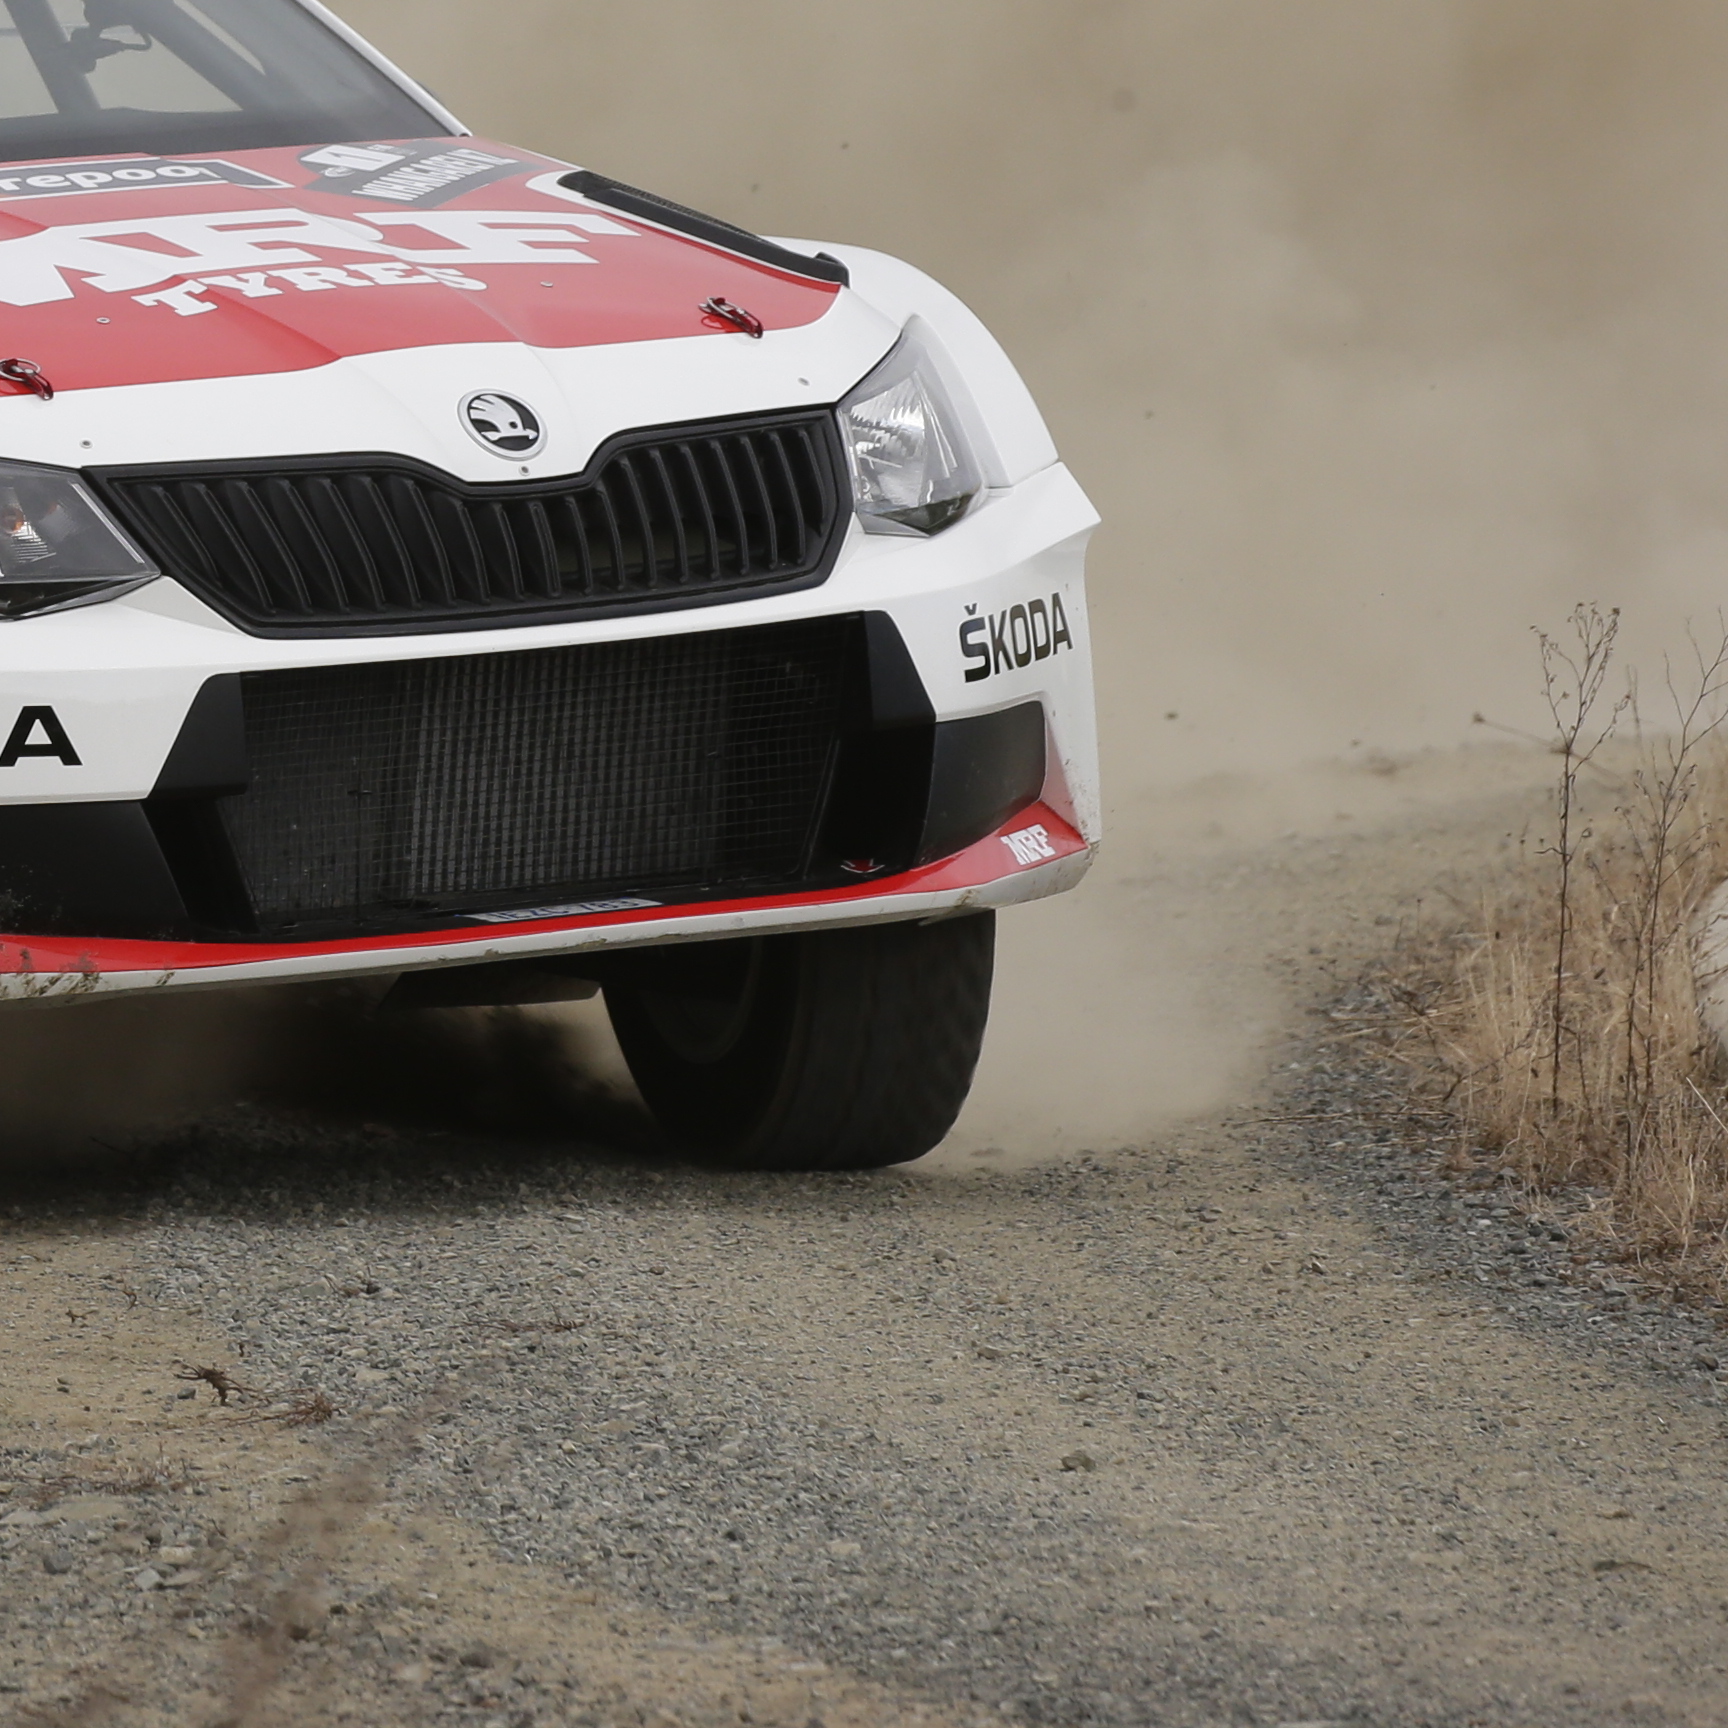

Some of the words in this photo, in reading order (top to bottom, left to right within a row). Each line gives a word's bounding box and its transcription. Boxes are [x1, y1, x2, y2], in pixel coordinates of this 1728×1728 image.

[130, 261, 488, 317] TYRES
[958, 592, 1073, 683] ŠKODA
[1001, 823, 1056, 866] MRF
